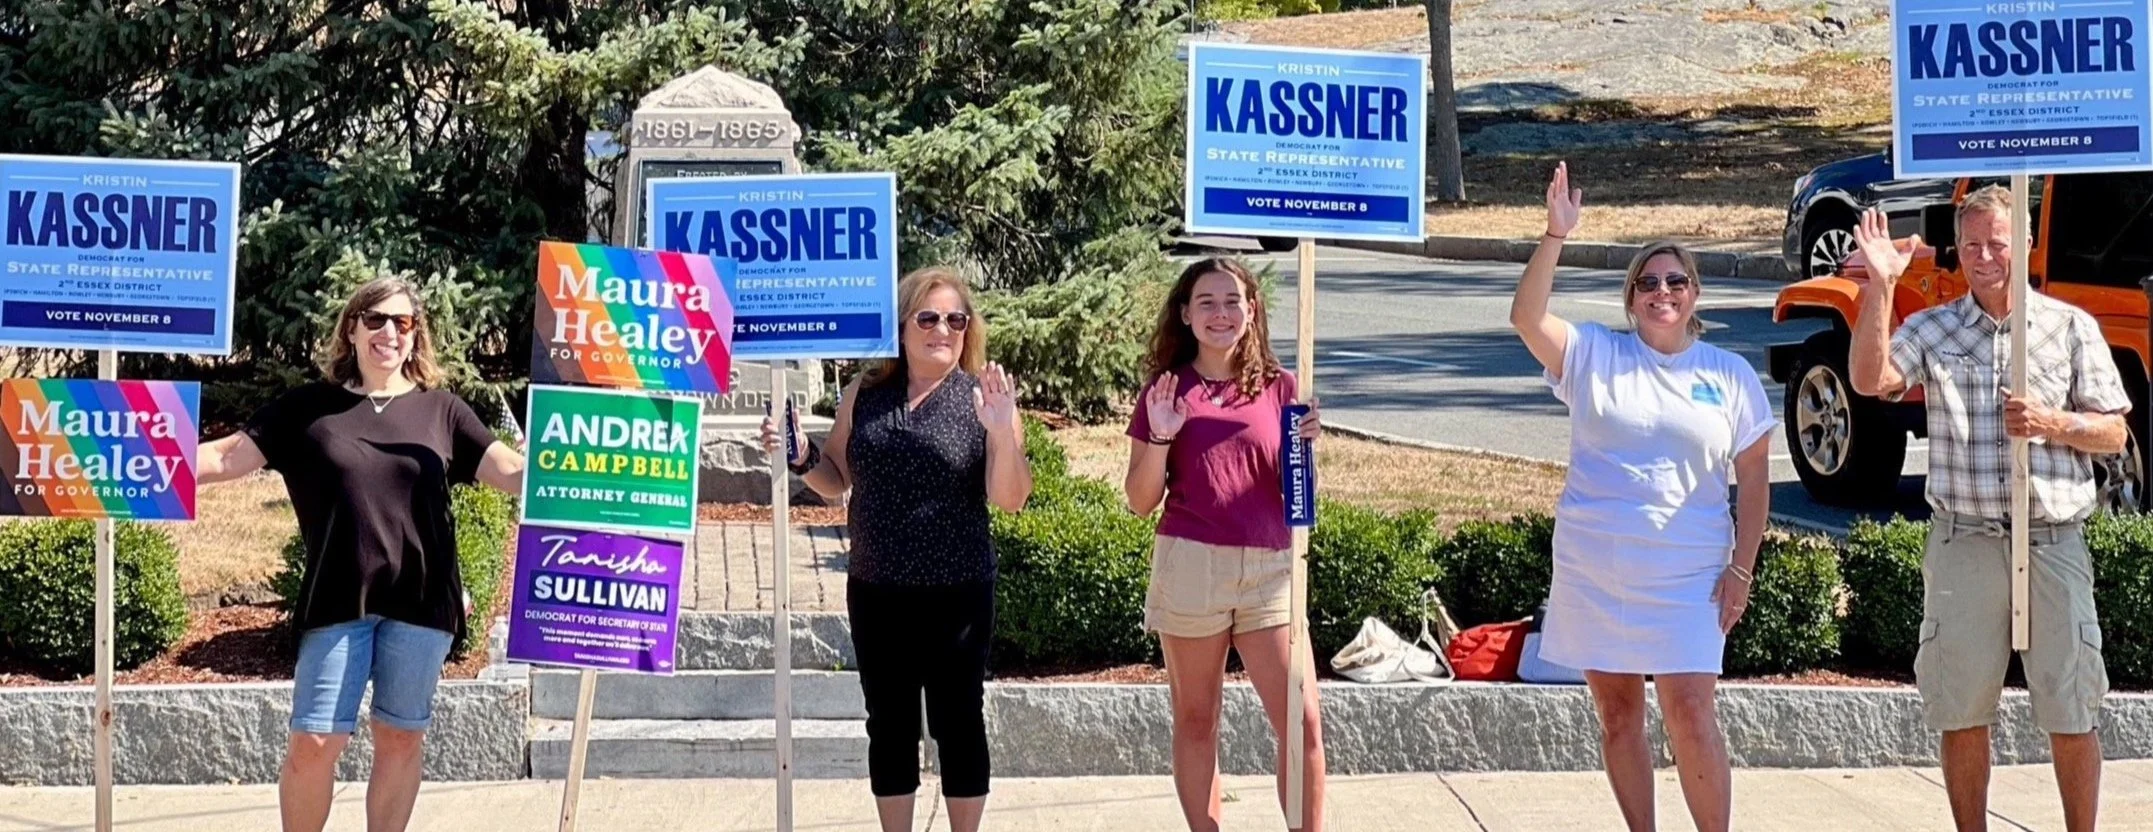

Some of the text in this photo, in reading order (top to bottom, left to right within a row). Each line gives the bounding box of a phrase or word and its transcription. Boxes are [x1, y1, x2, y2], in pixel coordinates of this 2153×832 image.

[1986, 0, 2055, 14] KRISTIN
[1909, 17, 2135, 79] KASSNER
[1278, 63, 1340, 76] KRISTIN
[1988, 81, 2037, 89] DEMOCRAT
[1206, 77, 1408, 142] KASSNER
[1989, 108, 2024, 117] ESSEX
[2028, 106, 2080, 115] DISTRICT
[1276, 142, 1321, 150] DEMOCRAT
[1959, 136, 2092, 150] VOTE NOVEMBER 8
[83, 174, 147, 187] KRISTIN
[1276, 169, 1308, 177] ESSEX
[1312, 170, 1358, 179] DISTRICT
[738, 191, 804, 202] KRISTIN
[1246, 197, 1368, 212] VOTE NOVEMBER 8
[6, 190, 217, 253] KASSNER
[665, 206, 878, 263] KASSNER
[78, 254, 125, 262] DEMOCRAT
[77, 281, 110, 290] ESSEX
[114, 282, 162, 291] DISTRICT
[555, 264, 711, 313] Maura
[739, 293, 825, 302] ESSEX DISTRICT
[46, 310, 172, 325] VOTE NOVEMBER 8
[551, 307, 716, 365] Healey
[750, 322, 825, 333] NOVEMBER
[829, 322, 837, 331] 8
[550, 348, 682, 369] FOR GOVERNOR
[17, 400, 176, 439] Maura
[540, 412, 690, 455] ANDREA
[15, 443, 183, 493] Healey
[538, 450, 689, 480] CAMPBELL
[1288, 412, 1303, 520] Maura Healey
[14, 484, 149, 498] FOR GOVERNOR
[536, 485, 688, 508] ATTORNEY GENERAL
[540, 534, 668, 575] Tanisha
[534, 575, 666, 612] SULLIVAN
[525, 610, 667, 633] DEMOCRAT FOR SECRETARY OF STATE
